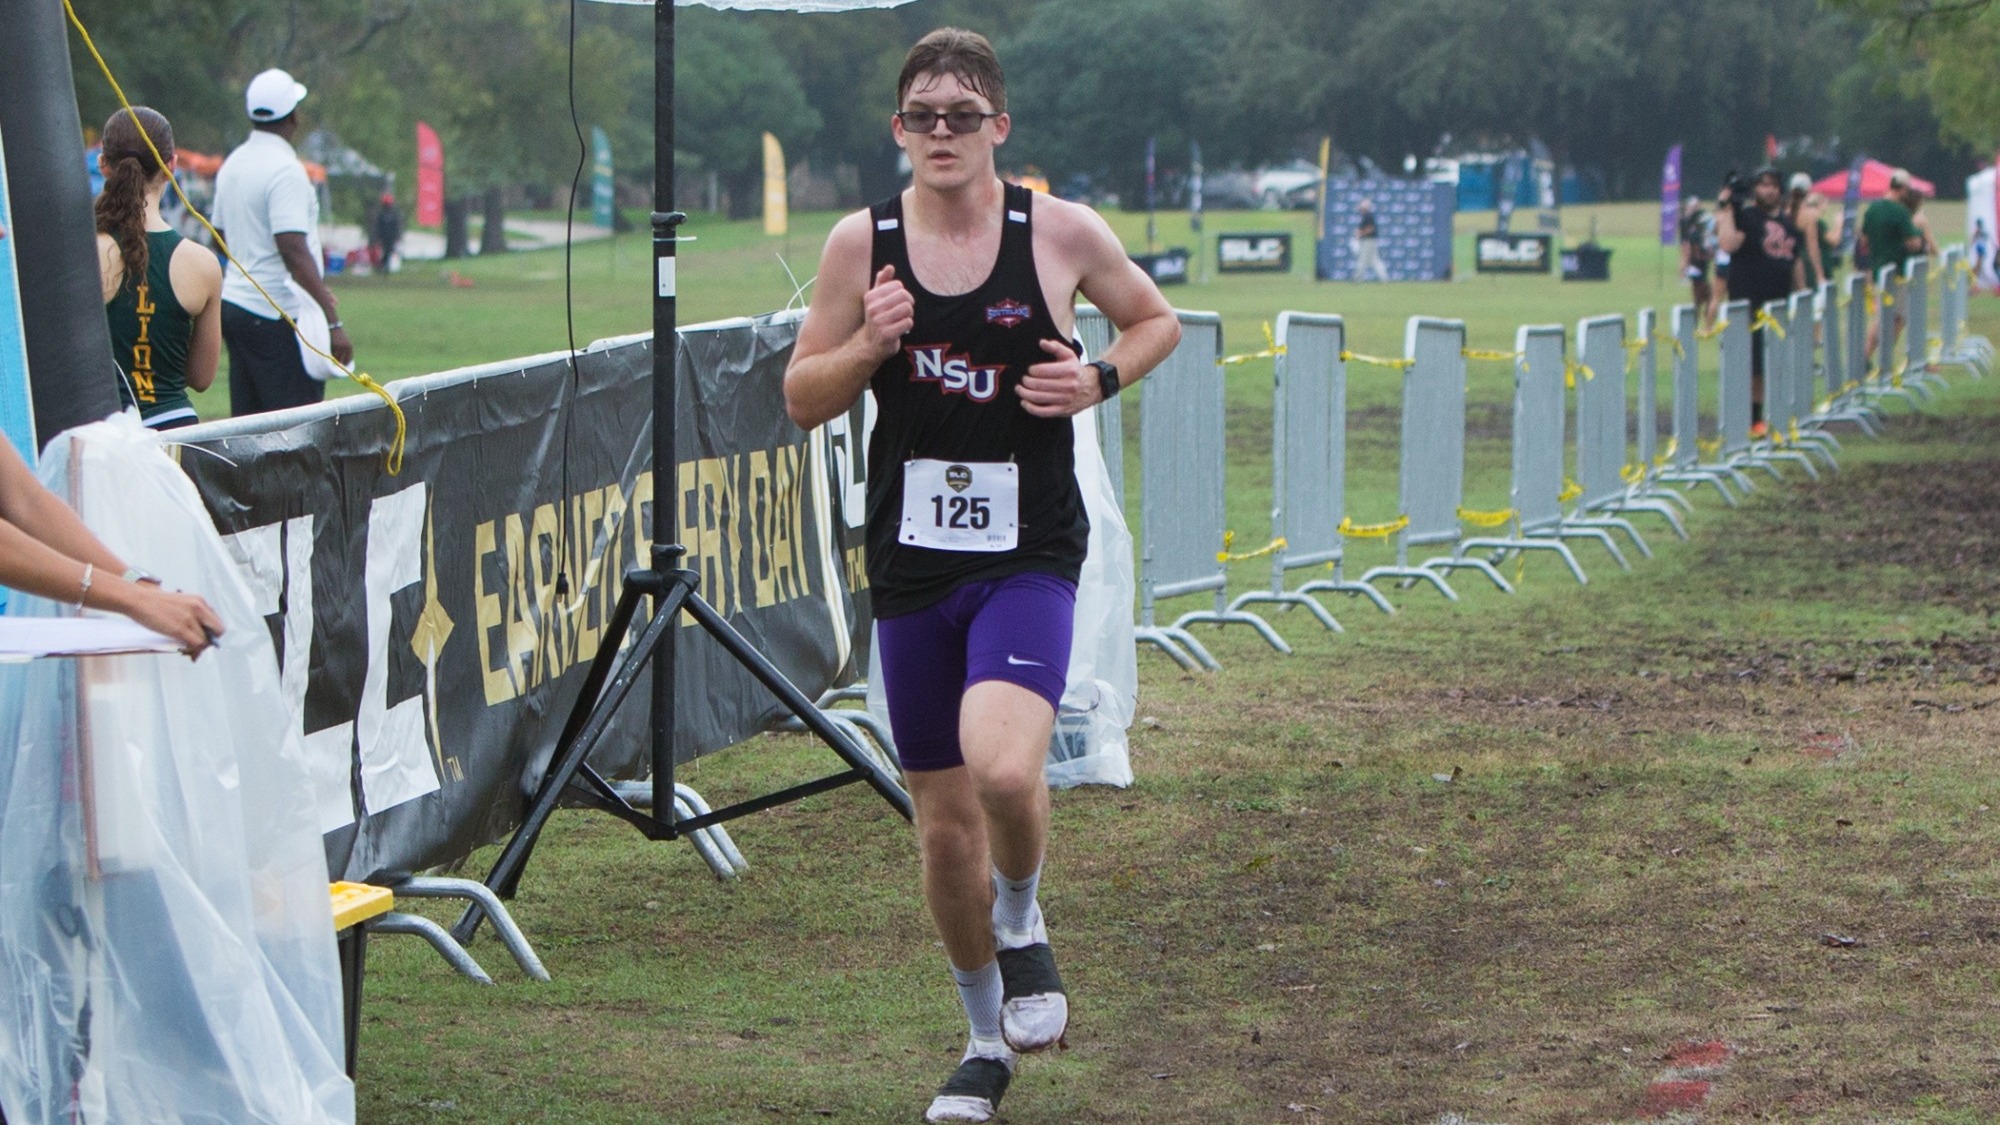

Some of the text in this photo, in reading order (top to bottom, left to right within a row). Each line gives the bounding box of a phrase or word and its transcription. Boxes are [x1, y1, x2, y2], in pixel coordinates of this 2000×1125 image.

[914, 349, 996, 399] NSU
[633, 454, 742, 627] EERY
[749, 442, 809, 608] DAY
[931, 495, 990, 530] 125
[220, 481, 441, 834] LC
